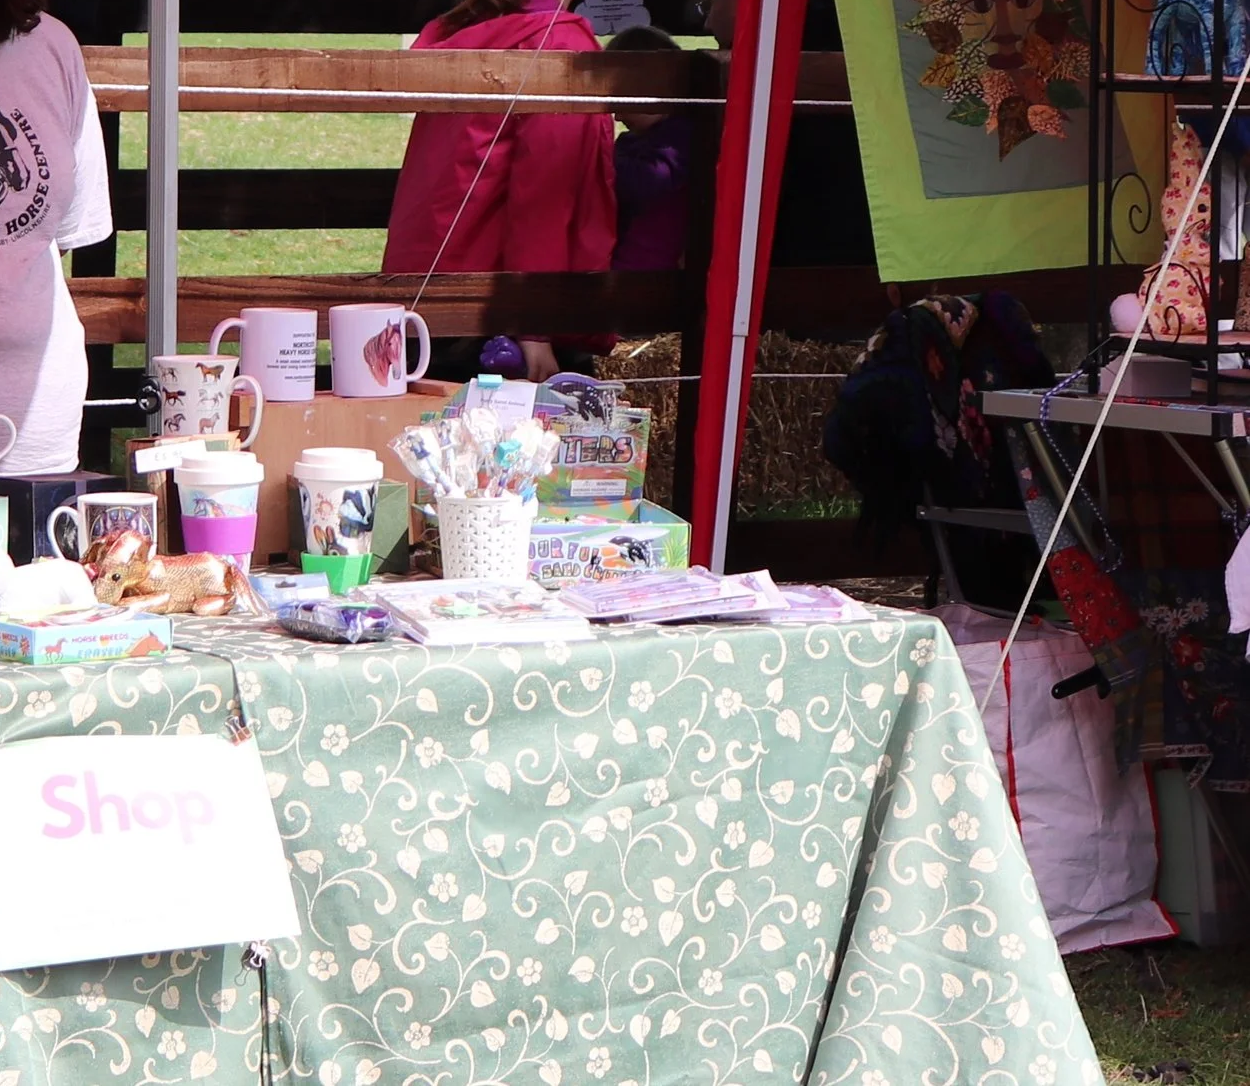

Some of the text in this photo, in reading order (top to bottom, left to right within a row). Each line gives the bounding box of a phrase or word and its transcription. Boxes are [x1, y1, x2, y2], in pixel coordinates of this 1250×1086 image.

[10, 108, 50, 181] CENTRE
[5, 183, 49, 236] HORSE
[100, 633, 129, 642] BREEDS
[41, 770, 216, 845] Shop
